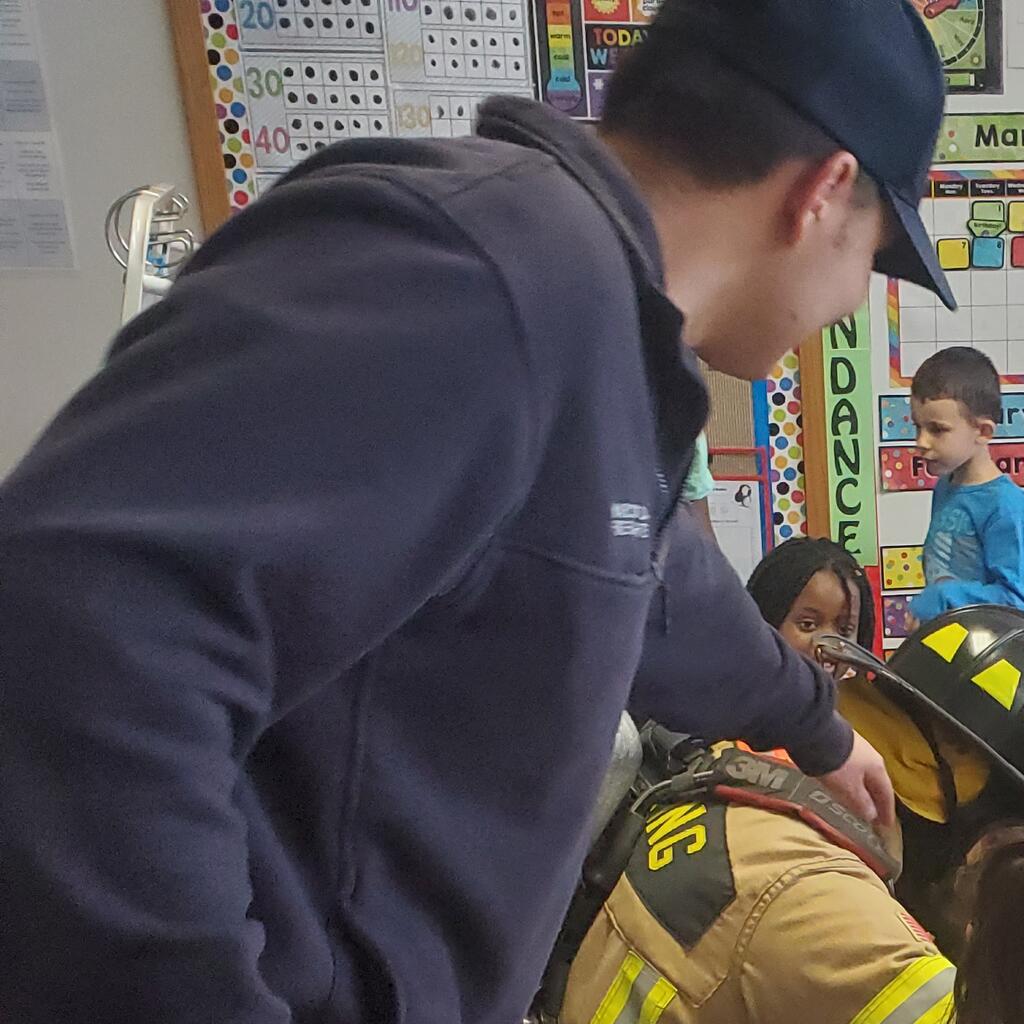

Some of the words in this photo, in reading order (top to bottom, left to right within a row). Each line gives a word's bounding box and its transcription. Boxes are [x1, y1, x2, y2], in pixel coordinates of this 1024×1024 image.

[240, 2, 273, 29] 20
[592, 28, 648, 46] TODA
[247, 67, 282, 98] 30
[255, 126, 290, 153] 40
[829, 314, 863, 554] NDANCE
[724, 757, 789, 789] 3M
[645, 802, 707, 872] NG
